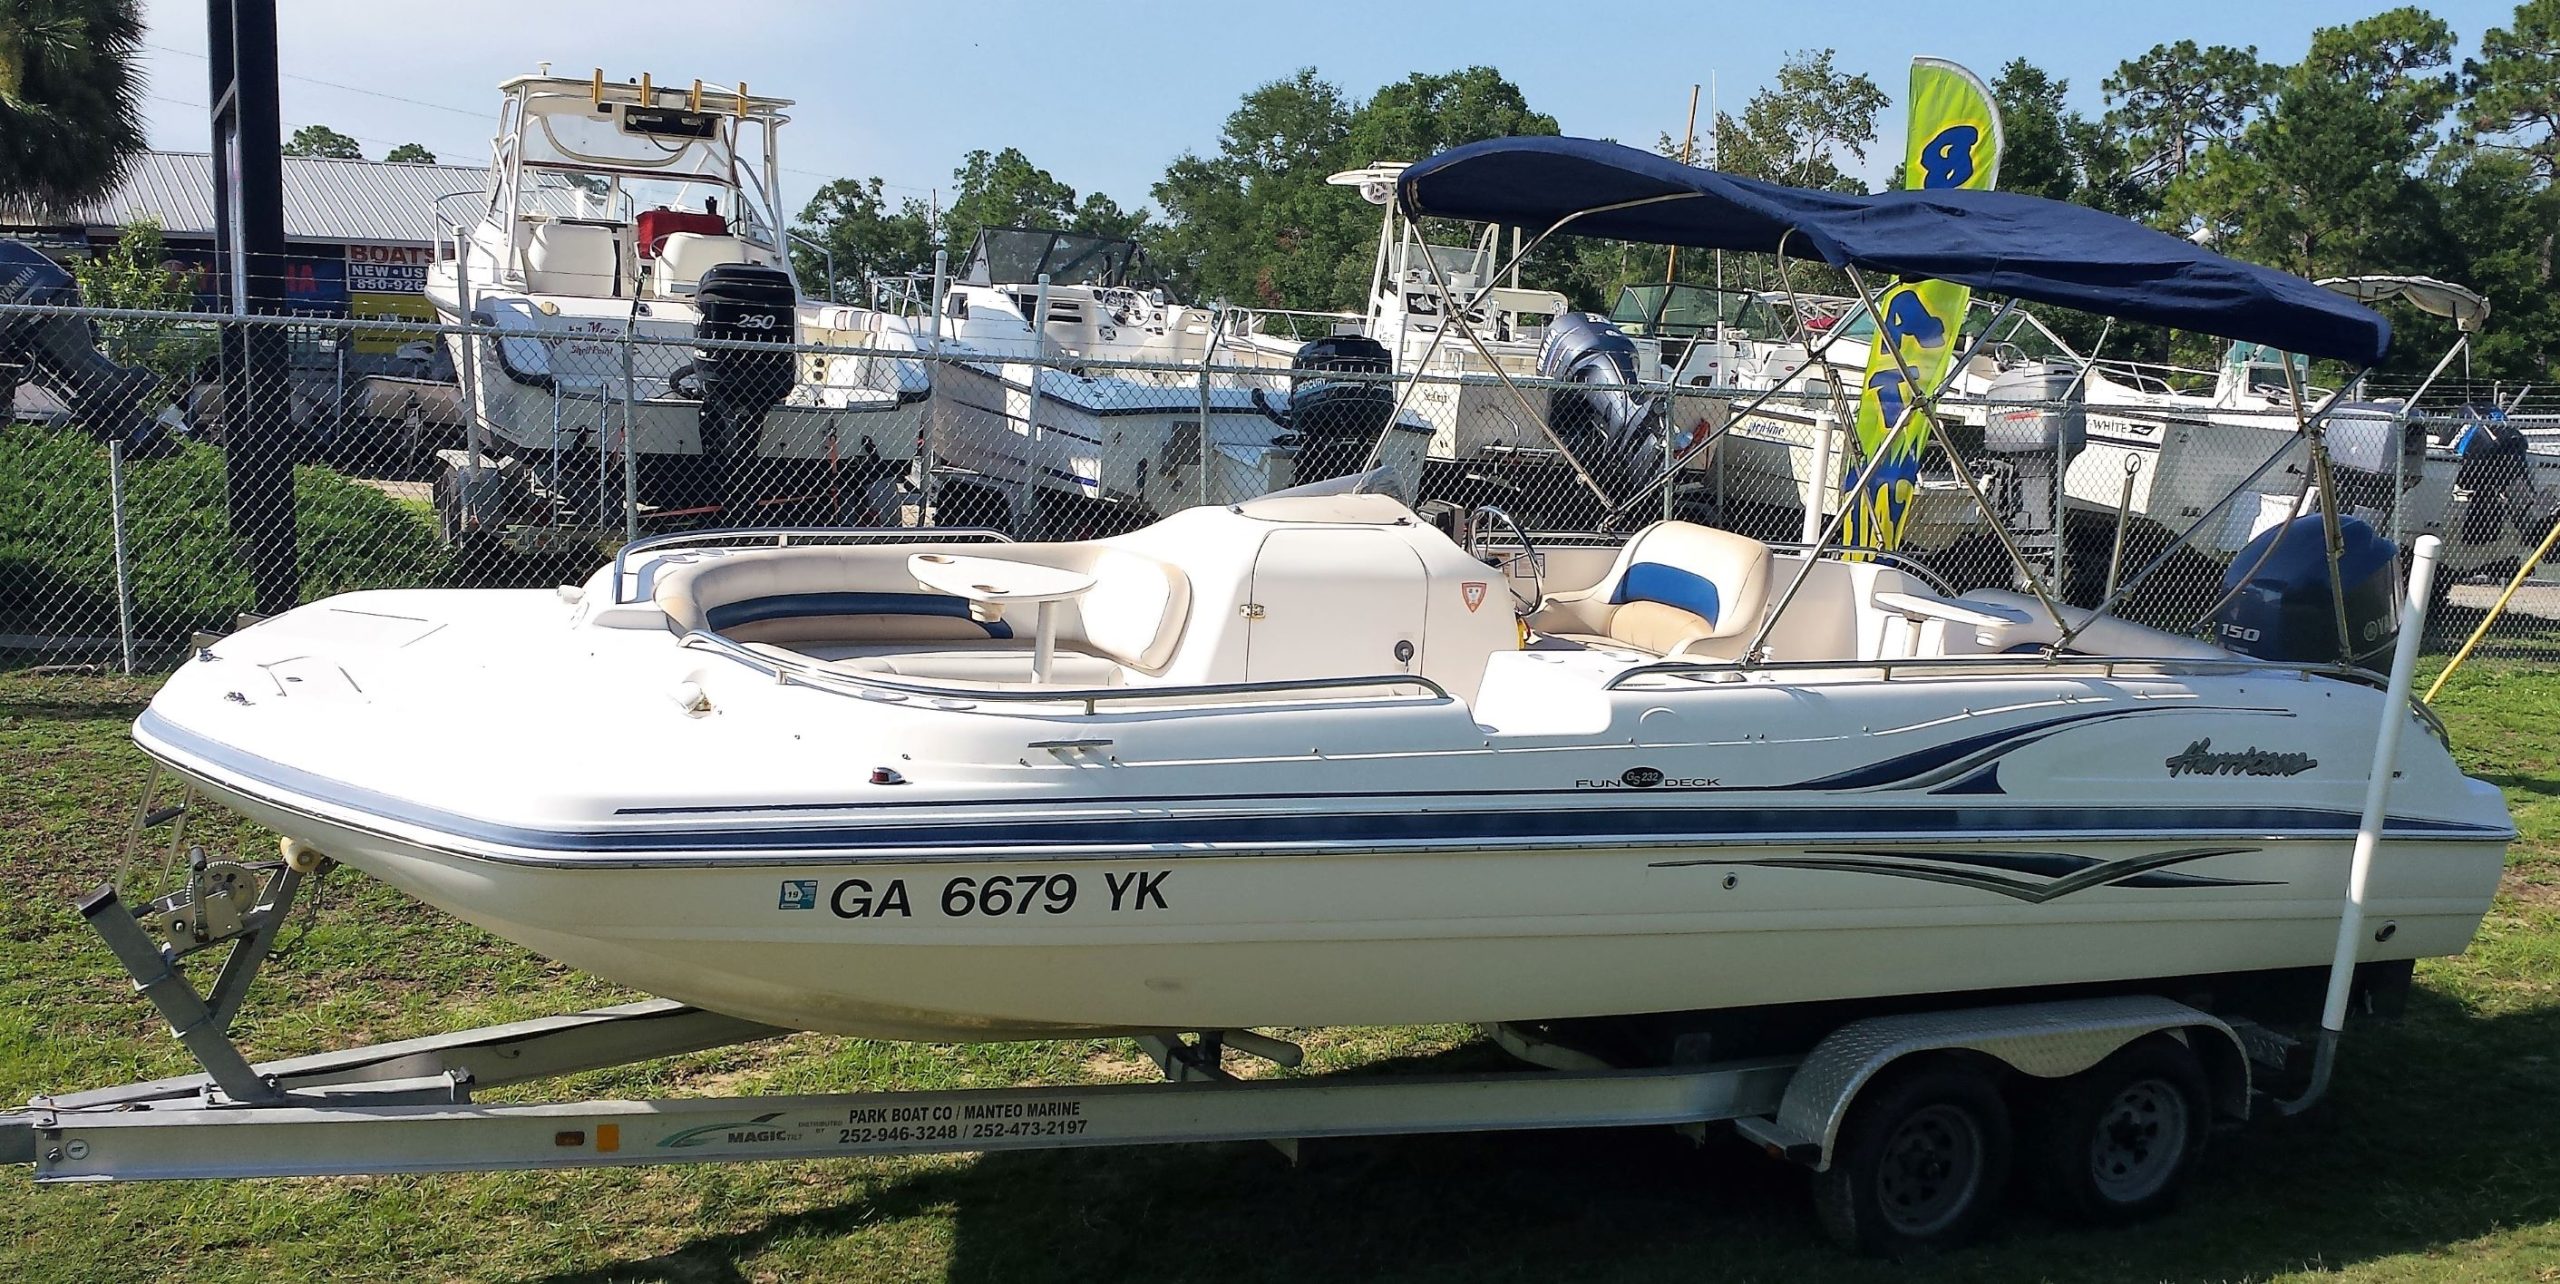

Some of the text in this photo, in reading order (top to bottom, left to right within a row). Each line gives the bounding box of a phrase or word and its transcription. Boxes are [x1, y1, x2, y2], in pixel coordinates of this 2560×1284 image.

[352, 265, 428, 278] NEW US
[0, 267, 36, 300] YAMAHA
[737, 314, 776, 329] 250
[2221, 623, 2260, 641] 150
[1575, 779, 1621, 788] FUN
[1664, 778, 1721, 787] DECK
[830, 870, 1172, 919] GA 6679 YK
[849, 1108, 888, 1124] PARK
[891, 1106, 929, 1122] BOAT
[932, 1106, 951, 1121] CO
[964, 1103, 1023, 1120] MANTEO
[1027, 1101, 1081, 1118] MARINE
[727, 1130, 786, 1144] MAGIC
[839, 1125, 958, 1144] 252-946-3248
[972, 1119, 1088, 1138] 252-473-2197
